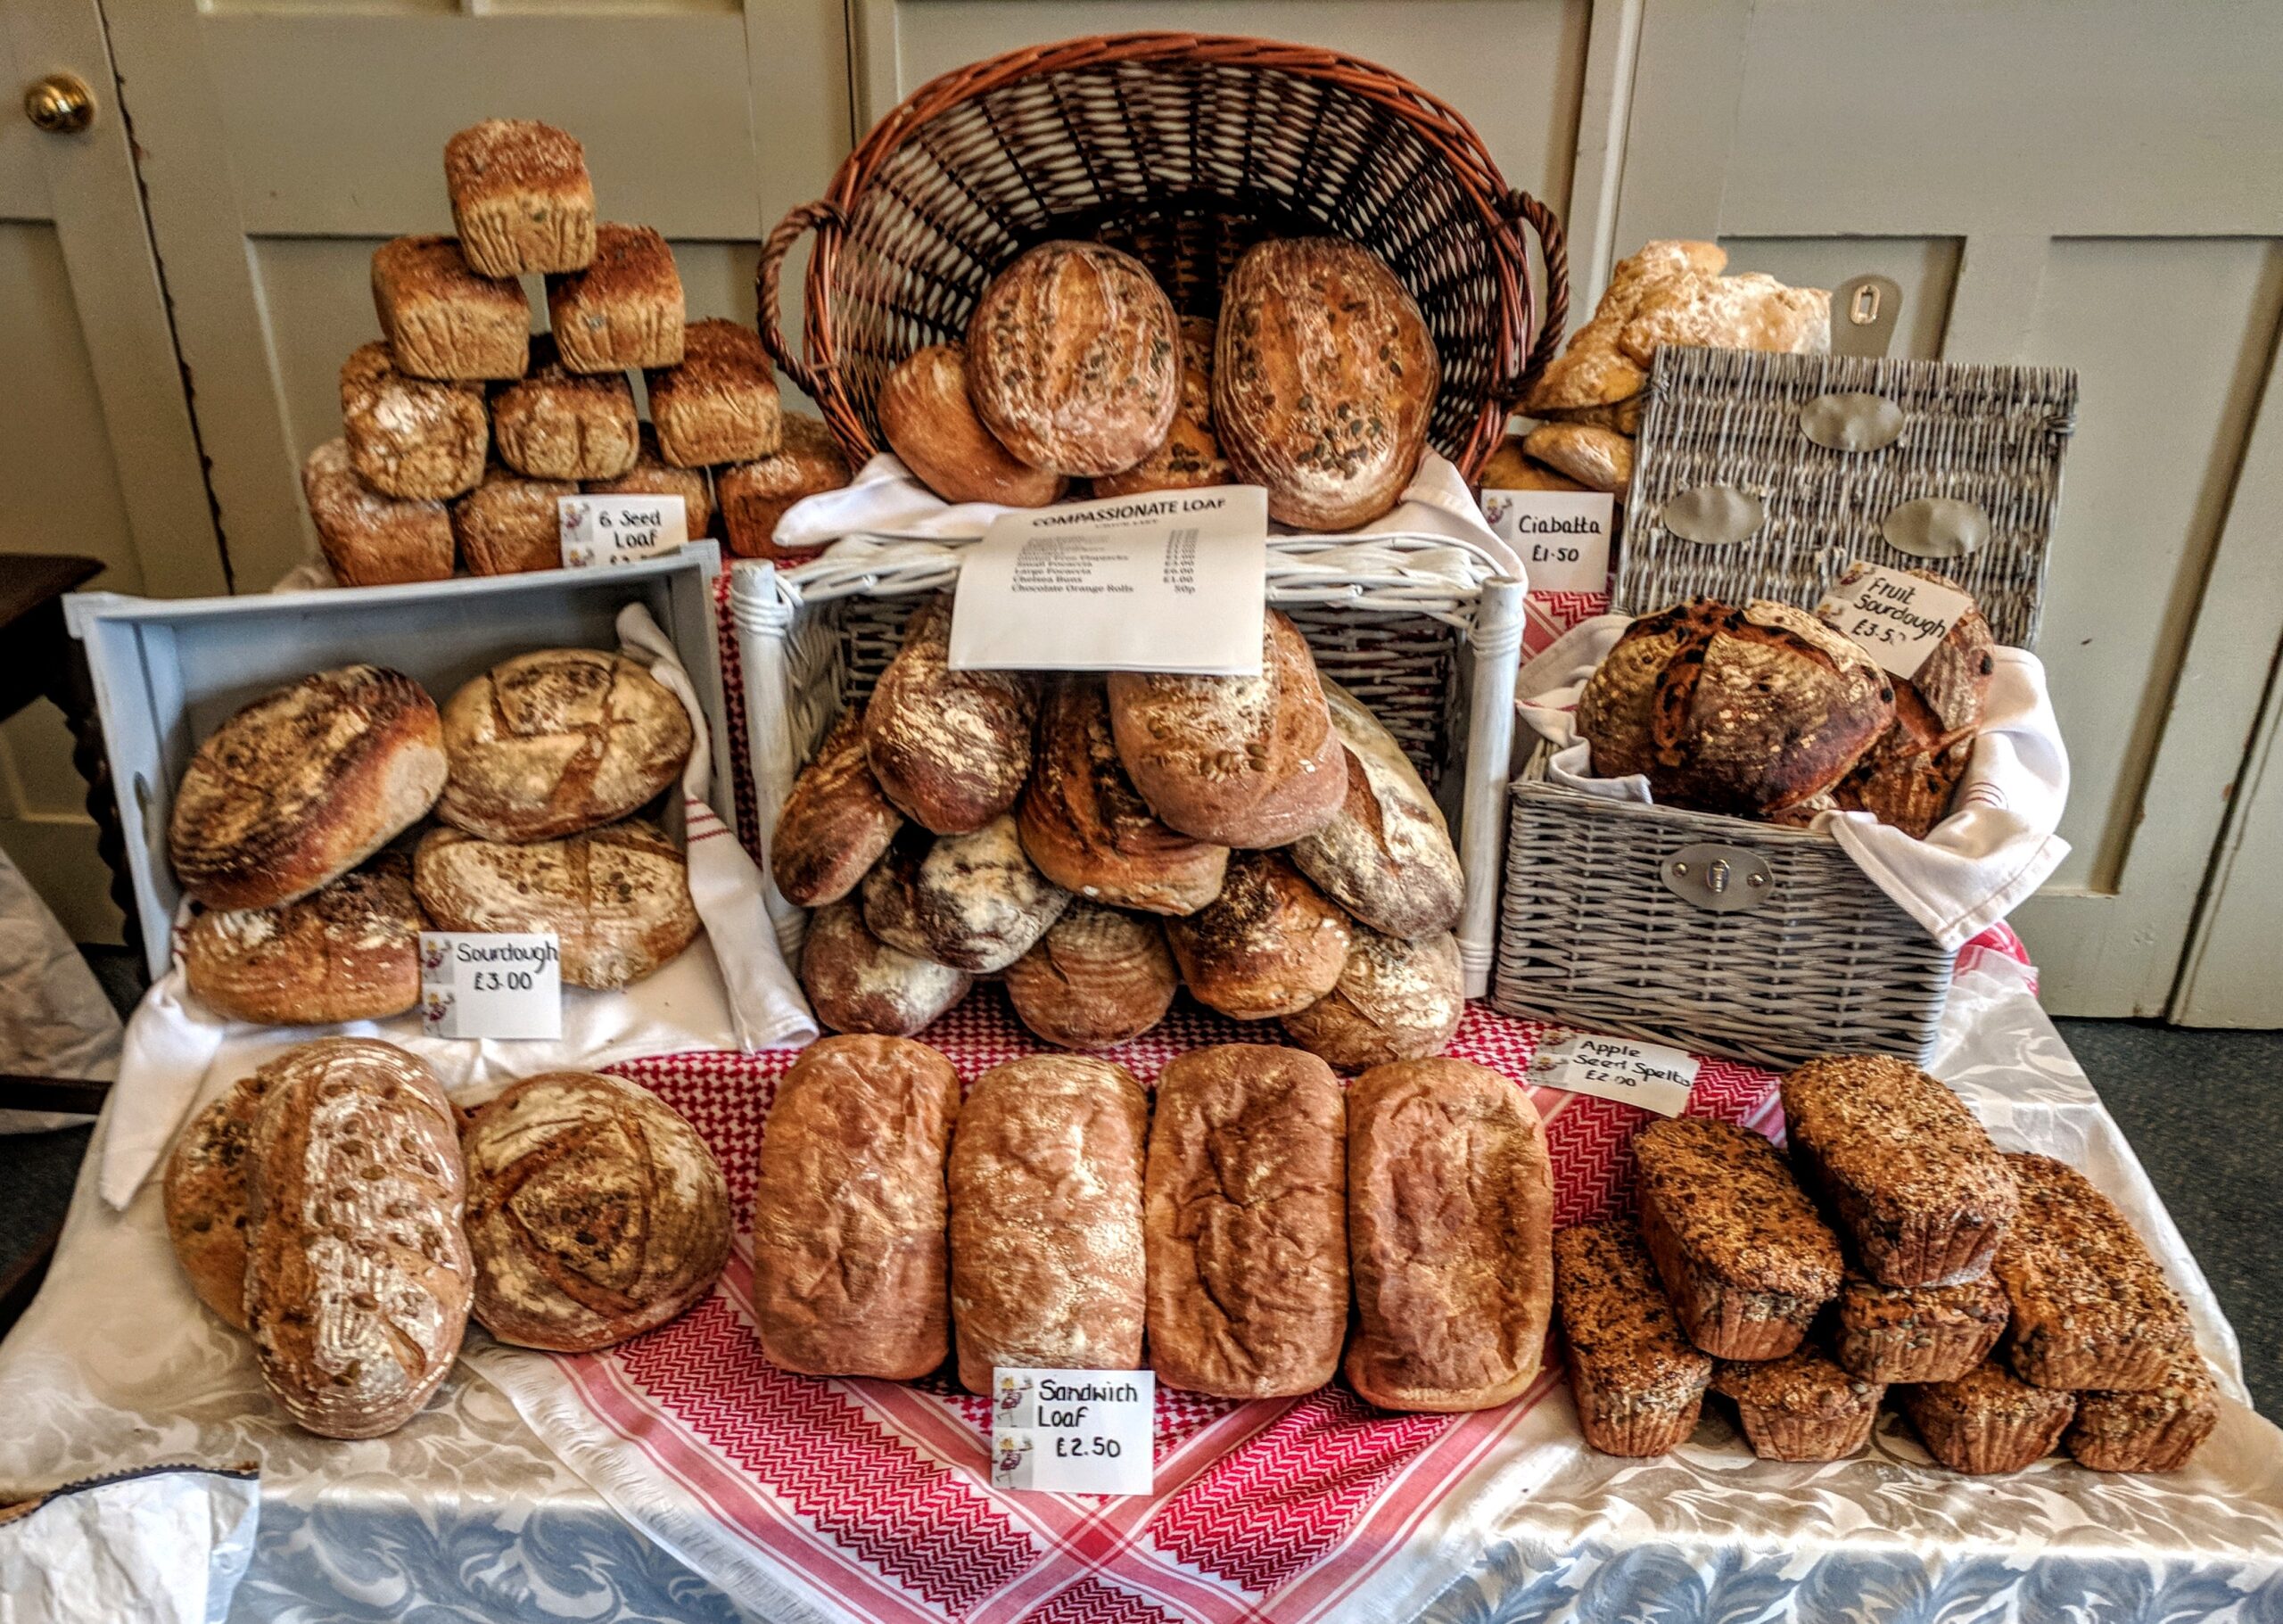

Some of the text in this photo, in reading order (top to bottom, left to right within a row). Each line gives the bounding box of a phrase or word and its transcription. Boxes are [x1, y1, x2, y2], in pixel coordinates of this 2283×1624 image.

[599, 508, 662, 528] 6 Seed
[1033, 501, 1178, 527] COMPASSIONATE
[1183, 499, 1226, 512] LOAF
[1519, 515, 1602, 534] Ciabatta
[614, 529, 658, 548] Loaf
[1011, 584, 1134, 594] Chocolate Orange Rolls
[1867, 577, 1917, 606] Fruit
[1853, 594, 1947, 641] Sourdough
[457, 940, 559, 974] Sourdough
[474, 971, 532, 991] £3.00
[1580, 1040, 1642, 1058] Apple
[1585, 1069, 1636, 1087] £200
[1039, 1379, 1138, 1402] Sandwich
[1038, 1405, 1089, 1428] Loaf
[1056, 1437, 1121, 1458] £2.50
